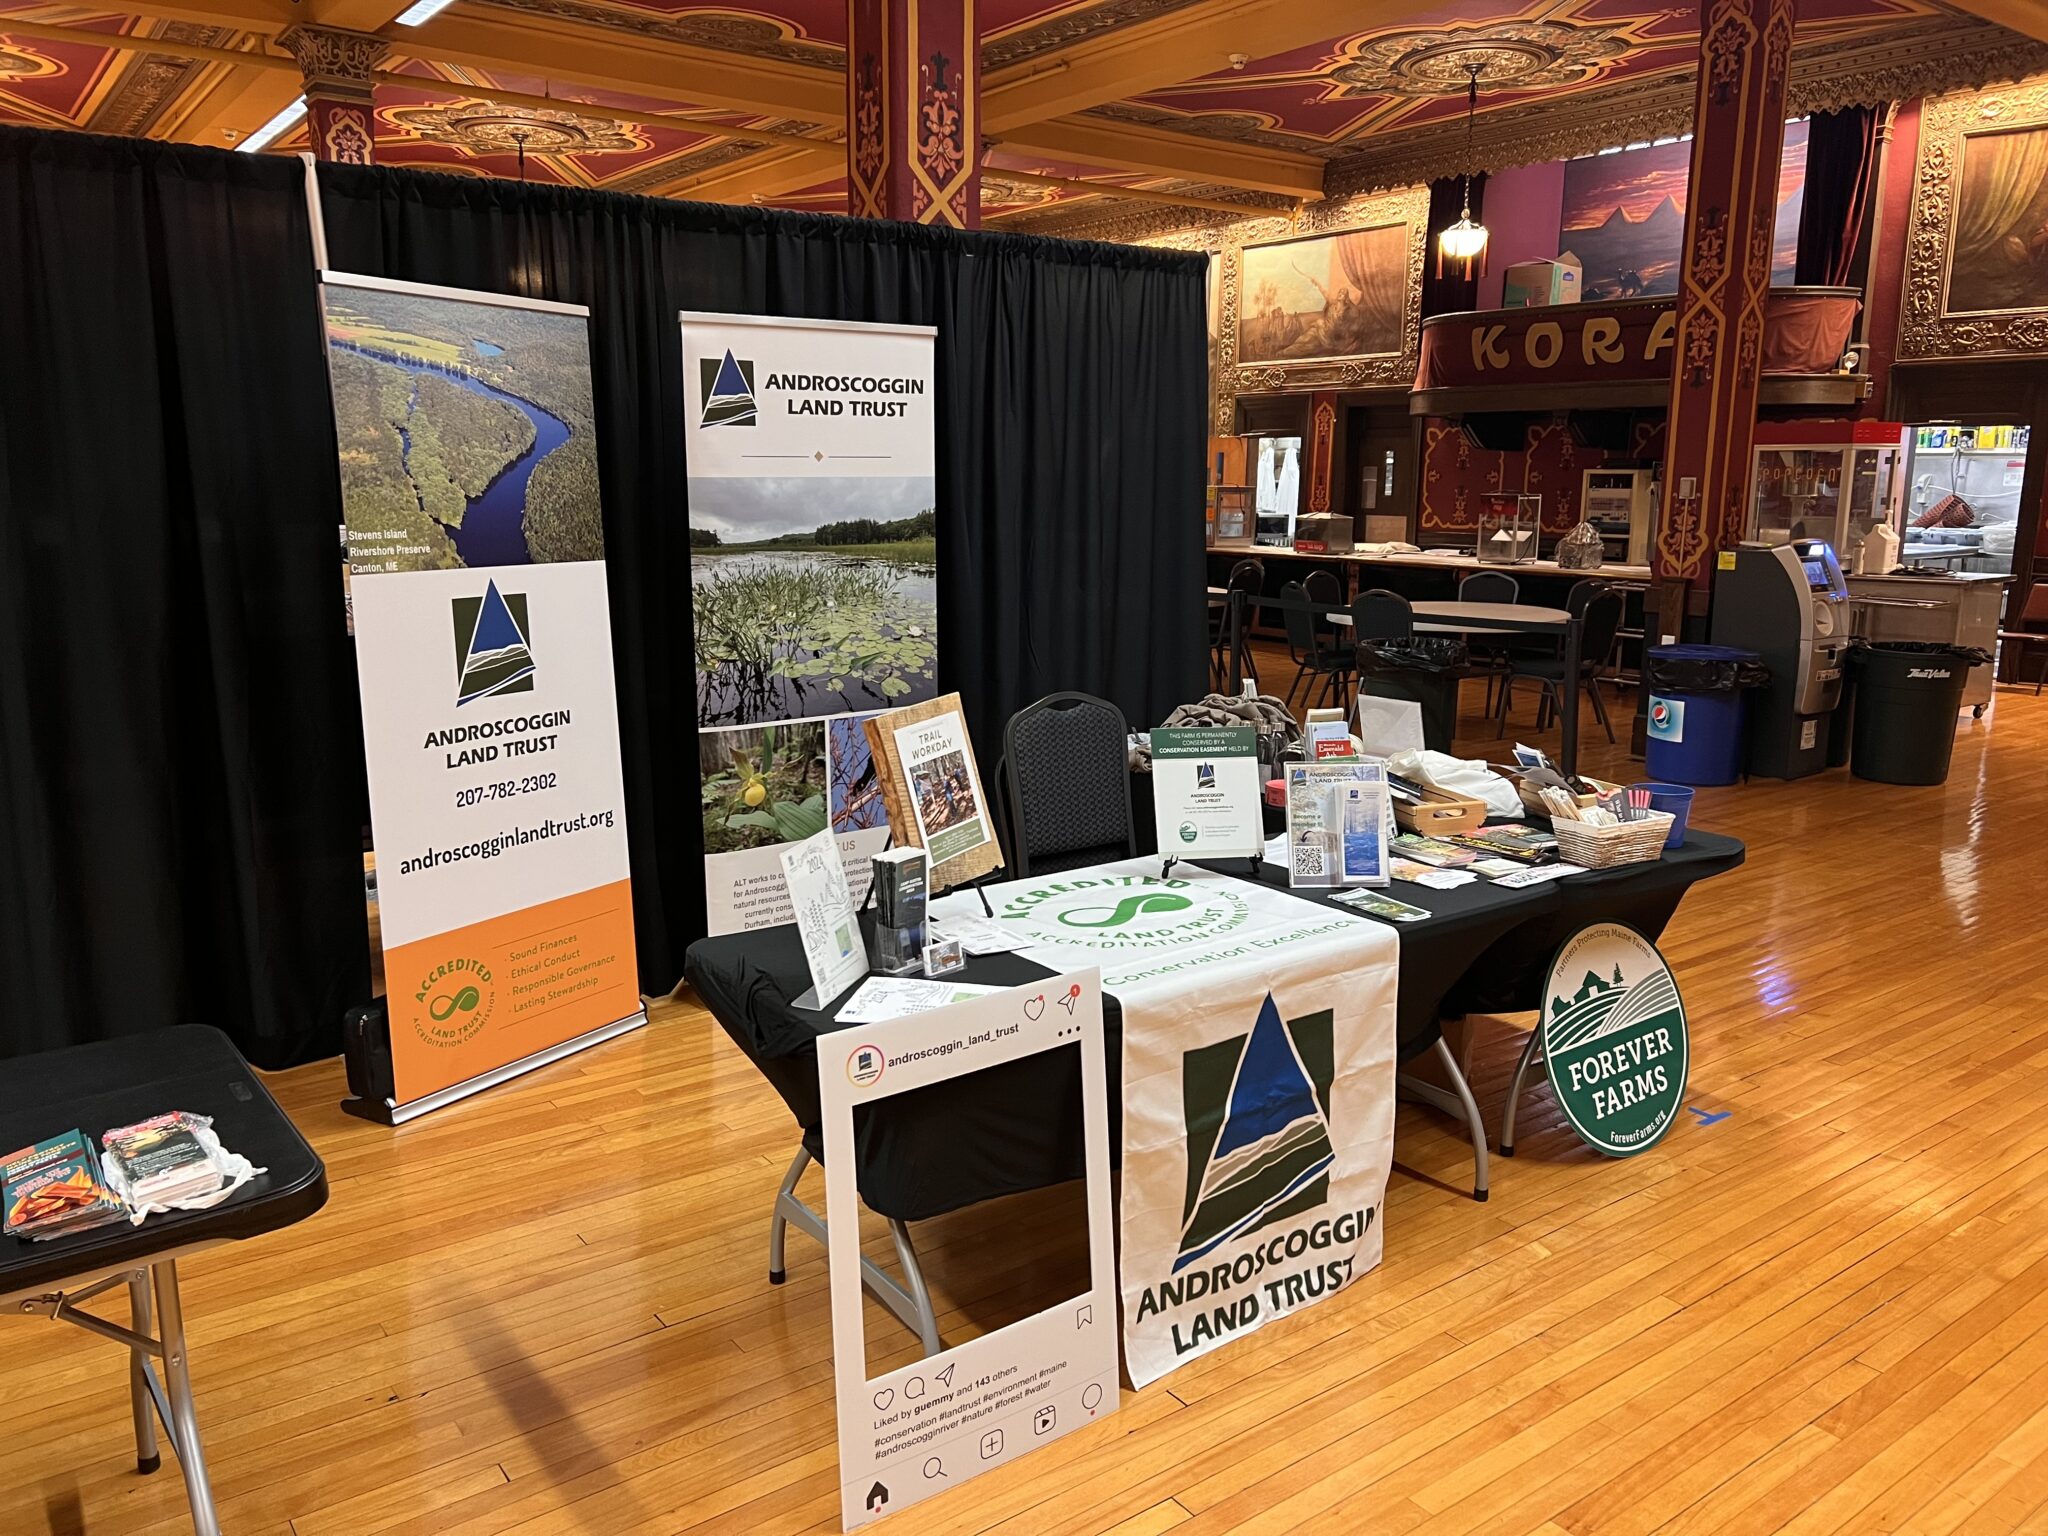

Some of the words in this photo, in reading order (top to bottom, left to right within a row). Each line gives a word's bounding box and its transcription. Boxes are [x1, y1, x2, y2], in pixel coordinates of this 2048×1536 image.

[1471, 310, 1677, 372] KORA
[764, 373, 924, 395] ANDROSCOGGIN
[787, 399, 844, 416] LAND
[849, 400, 908, 417] TRUST
[348, 530, 382, 541] Stevens
[384, 529, 408, 539] Island
[350, 546, 395, 557] Rivershore
[396, 545, 431, 555] Preserve
[351, 563, 385, 574] Canton,
[386, 562, 399, 571] ME
[424, 709, 571, 749] ANDROSCOGGIN
[918, 729, 942, 745] TRAIL
[446, 745, 499, 769] LAND
[503, 735, 558, 758] TRUST
[911, 738, 952, 760] WORKDAY
[1159, 746, 1199, 754] CONSERVATION
[456, 772, 557, 807] 207-782-2302
[400, 809, 614, 875] androscogginlandtrust.org
[842, 840, 856, 851] US
[847, 856, 869, 866] critical
[733, 878, 747, 887] ALT
[748, 875, 769, 885] works
[1001, 876, 1191, 920] ACCREDITED
[733, 899, 757, 909] natural
[758, 893, 790, 905] resources
[744, 907, 774, 918] currently
[744, 919, 773, 930] Durham,
[1026, 930, 1210, 950] ACCREDITATION
[1098, 927, 1175, 940] LAND
[1176, 908, 1225, 932] TRUST
[509, 946, 538, 962] Sound
[540, 935, 577, 952] Finances
[511, 961, 541, 979] Ethical
[543, 949, 581, 968] Conduct
[1556, 944, 1578, 978] Partners
[1576, 928, 1610, 947] Protecting
[1611, 928, 1632, 943] Maine
[1632, 937, 1652, 959] Farms
[415, 958, 492, 1003] ACCREDITED
[512, 972, 564, 996] Responsible
[566, 955, 616, 977] Governance
[1103, 945, 1250, 987] Conservation
[514, 995, 545, 1013] Lasting
[547, 977, 599, 1001] Stewardship
[413, 1017, 462, 1048] ACCREDITATION
[463, 991, 495, 1042] COMMISSION
[431, 1026, 455, 1039] LAND
[458, 1010, 482, 1036] TRUST
[888, 1023, 1019, 1068] androscoggin_land_trust
[1568, 1027, 1673, 1092] FOREVER
[1592, 1065, 1668, 1121] FARMS
[1610, 1109, 1667, 1144] ForeverFarms.org
[1136, 1201, 1381, 1325] ANDROSCOGGIN
[1171, 1294, 1260, 1356] LAND
[1264, 1254, 1356, 1311] TRUST
[874, 1413, 899, 1430] Liked
[900, 1409, 912, 1423] by
[914, 1392, 954, 1416] guemmy
[956, 1384, 973, 1398] and
[974, 1376, 990, 1389] 143
[992, 1365, 1018, 1383] others
[874, 1417, 937, 1448] #conservation
[939, 1397, 982, 1421] #landtrust
[982, 1374, 1038, 1404] #environment
[1039, 1360, 1067, 1380] #maine
[875, 1420, 959, 1460] #androscogginriver
[961, 1404, 993, 1425] #nature
[995, 1391, 1023, 1410] #forest
[1024, 1379, 1052, 1398] #water
